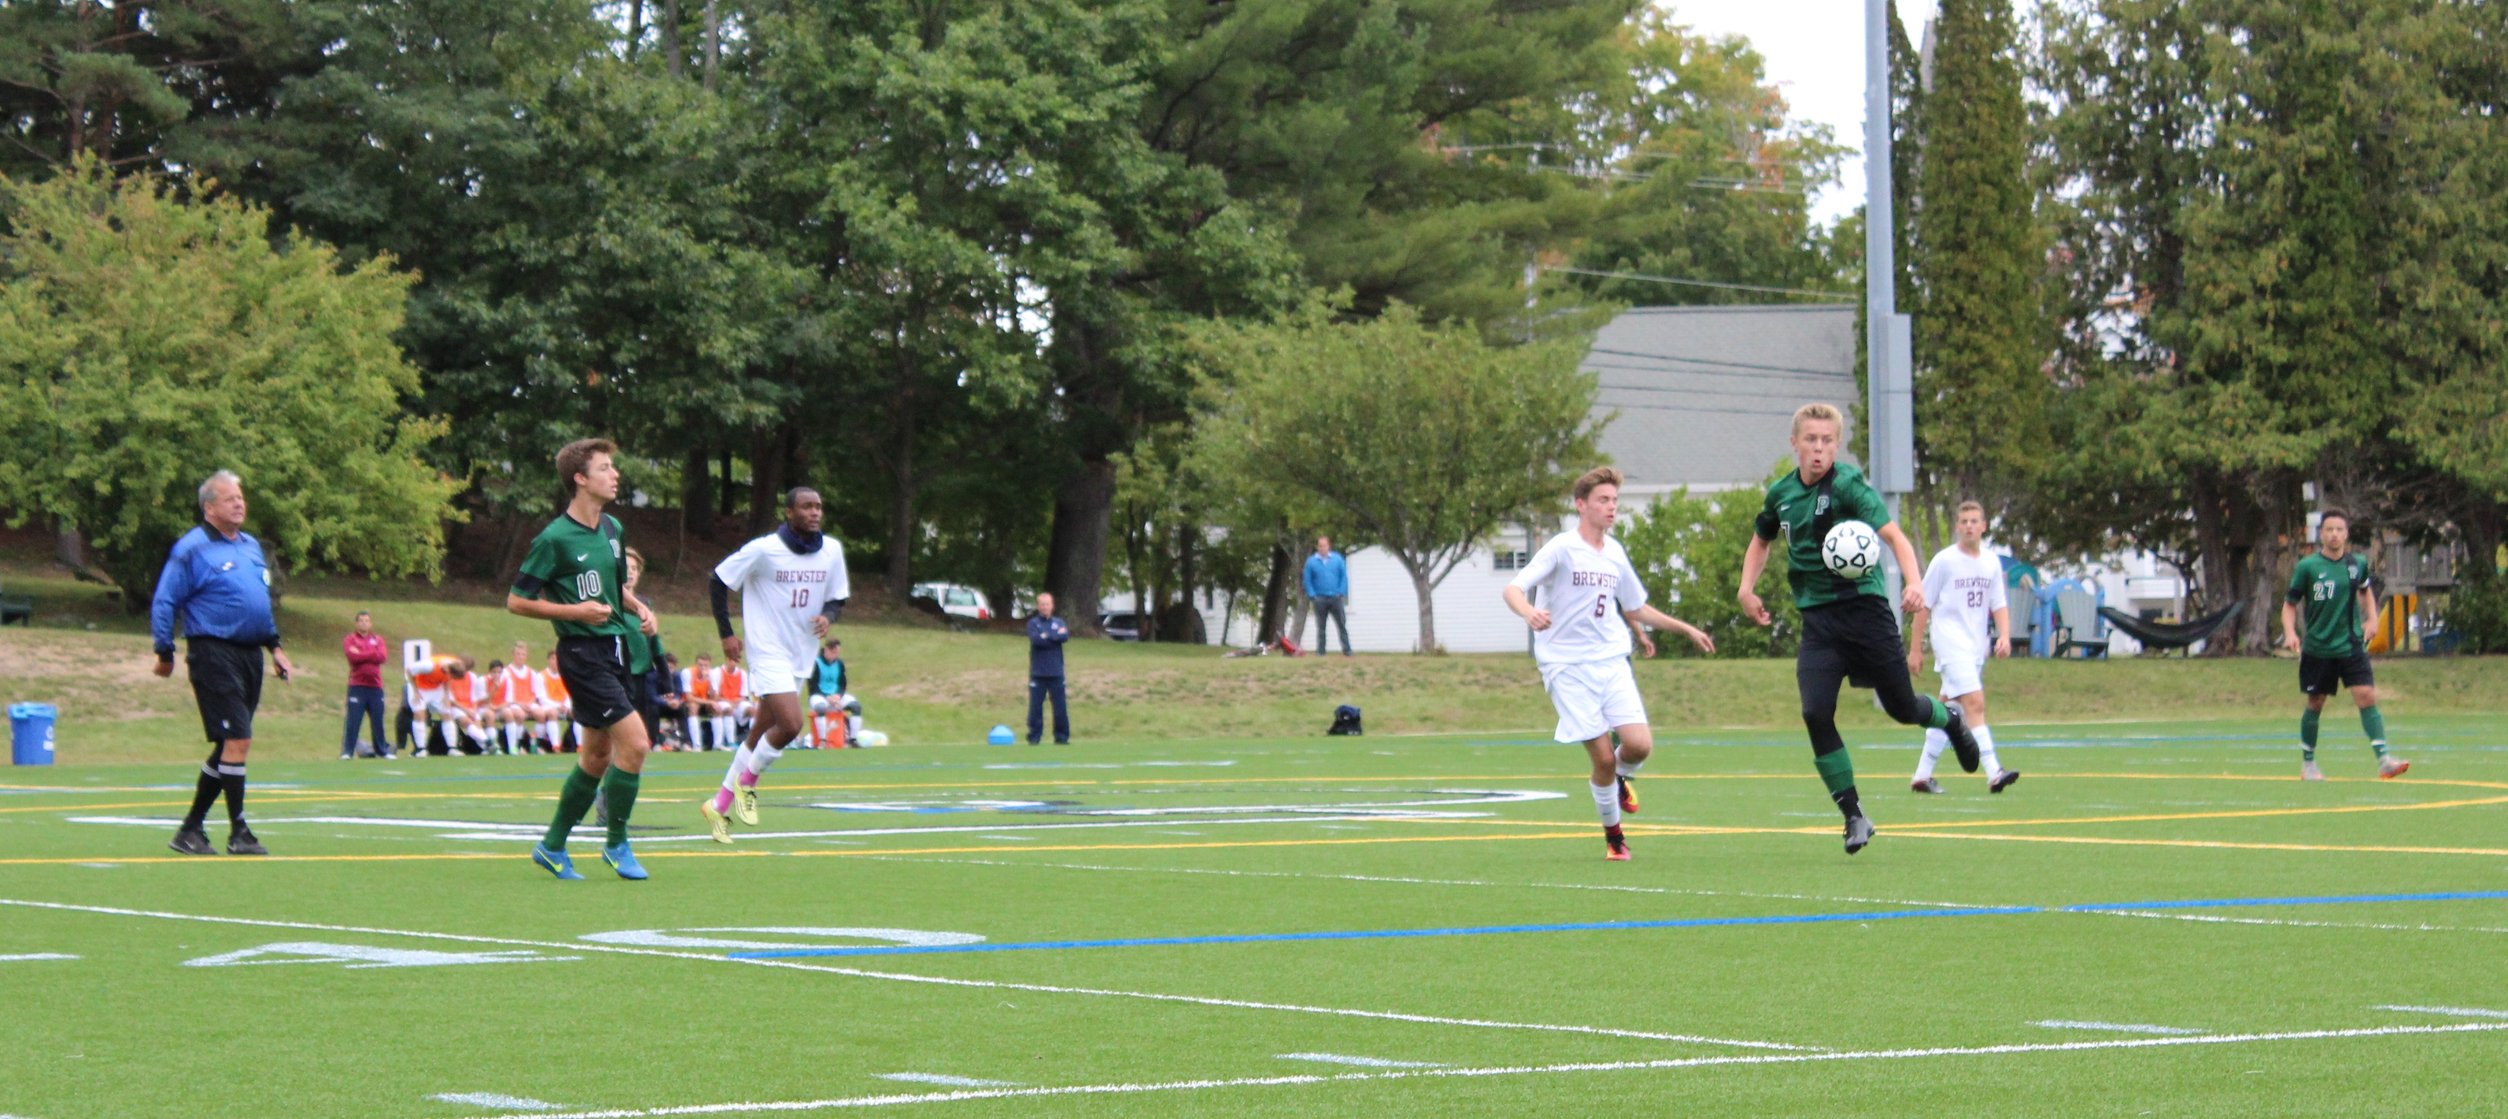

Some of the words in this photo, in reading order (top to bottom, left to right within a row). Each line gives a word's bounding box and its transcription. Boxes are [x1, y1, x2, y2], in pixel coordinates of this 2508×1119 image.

[1815, 495, 1830, 515] P
[577, 570, 601, 600] 10
[776, 570, 827, 583] BREWSTER
[1572, 571, 1619, 590] BREWSTE
[790, 588, 809, 608] 10
[1967, 591, 1983, 608] 23
[2313, 580, 2335, 601] 27
